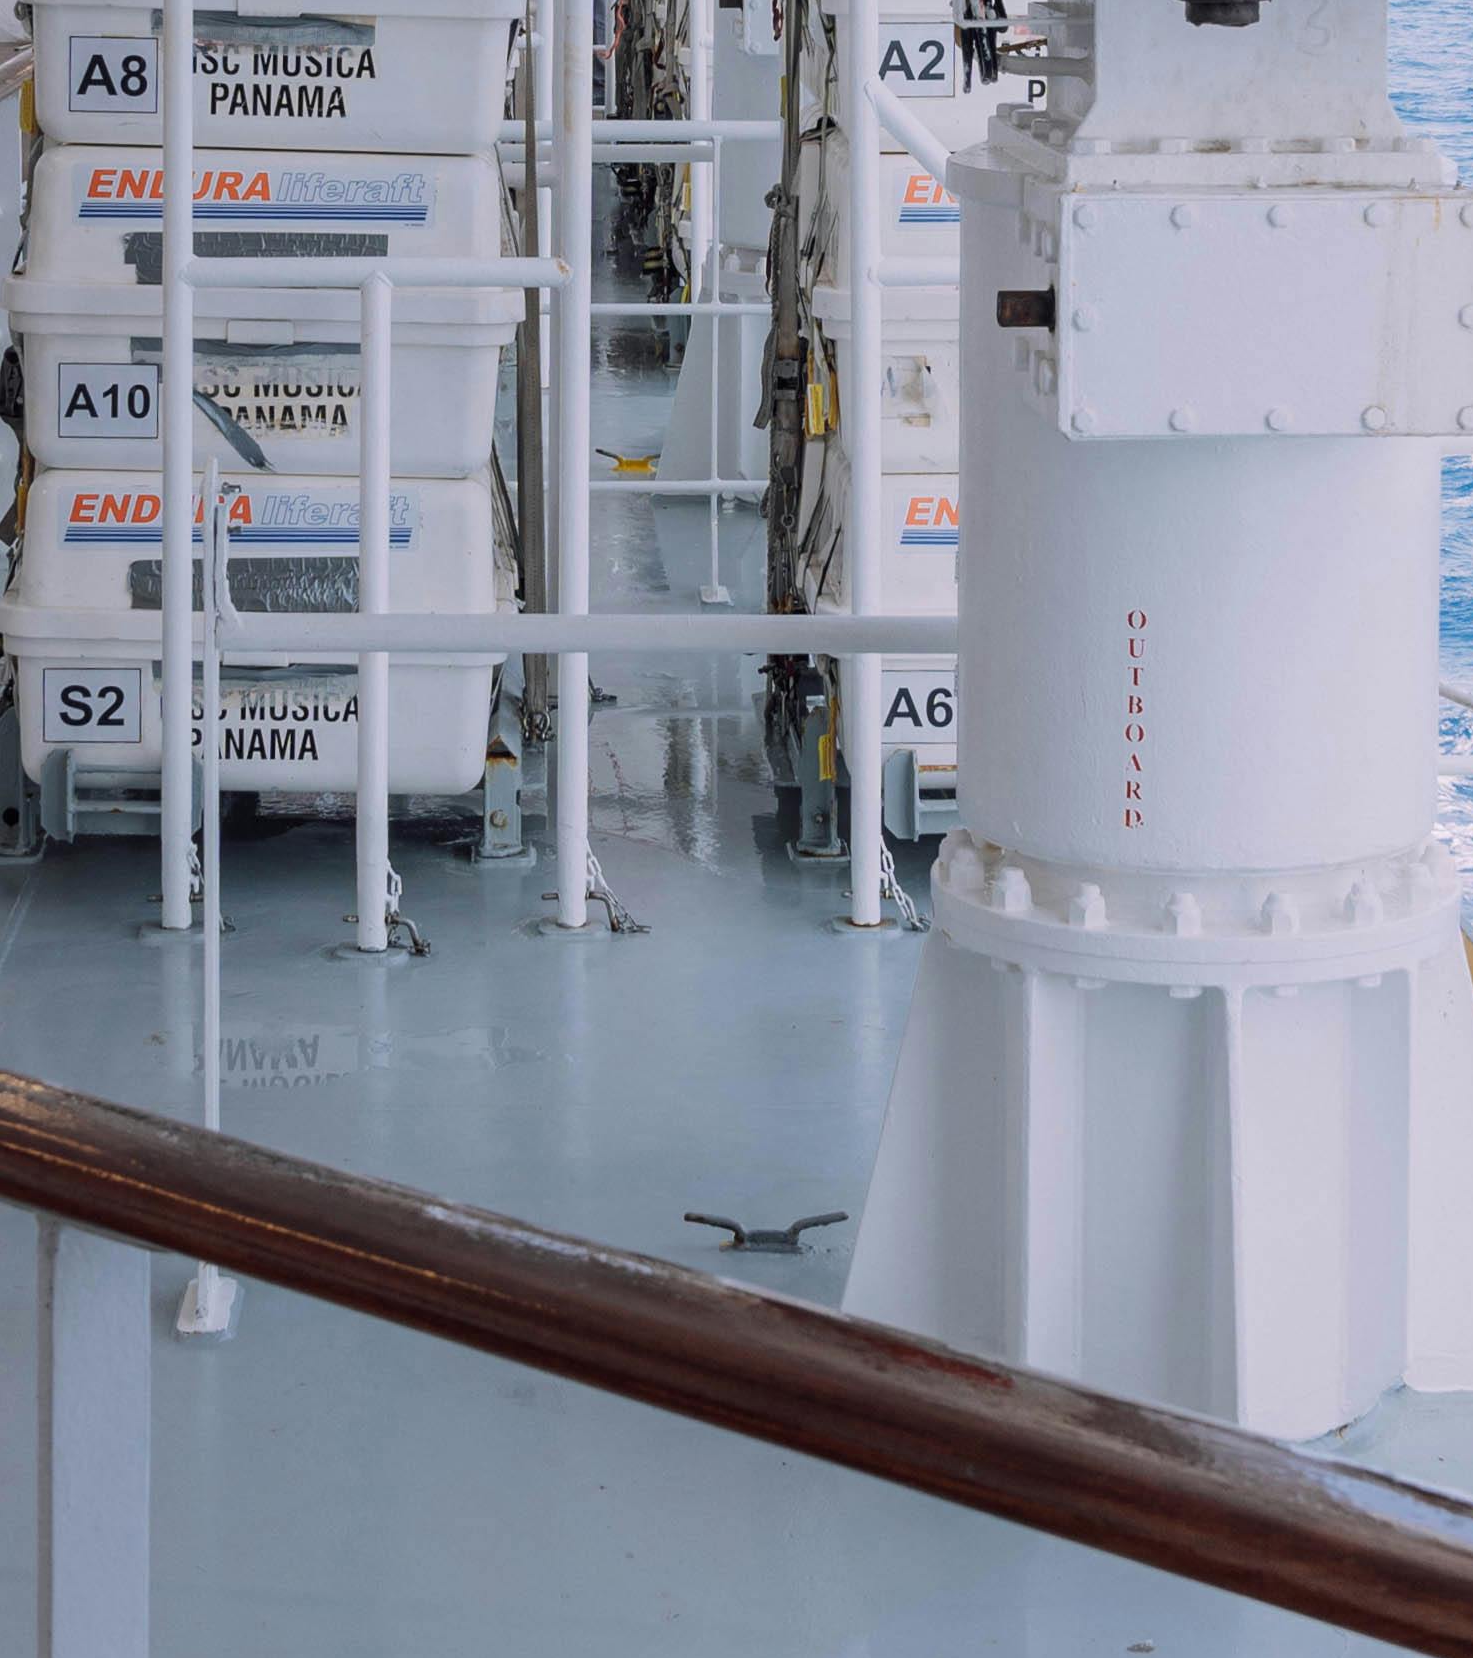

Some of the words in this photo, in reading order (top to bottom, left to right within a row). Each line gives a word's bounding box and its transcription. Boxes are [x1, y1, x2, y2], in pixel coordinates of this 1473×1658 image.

[77, 54, 148, 97] A8
[193, 46, 240, 75] SC
[878, 39, 945, 81] A2
[210, 82, 346, 118] PANAMA
[276, 172, 425, 204] liferaft
[64, 383, 151, 419] A10
[59, 685, 125, 727] S2
[883, 688, 954, 728] A6
[1125, 609, 1147, 829] OUTBOARD
